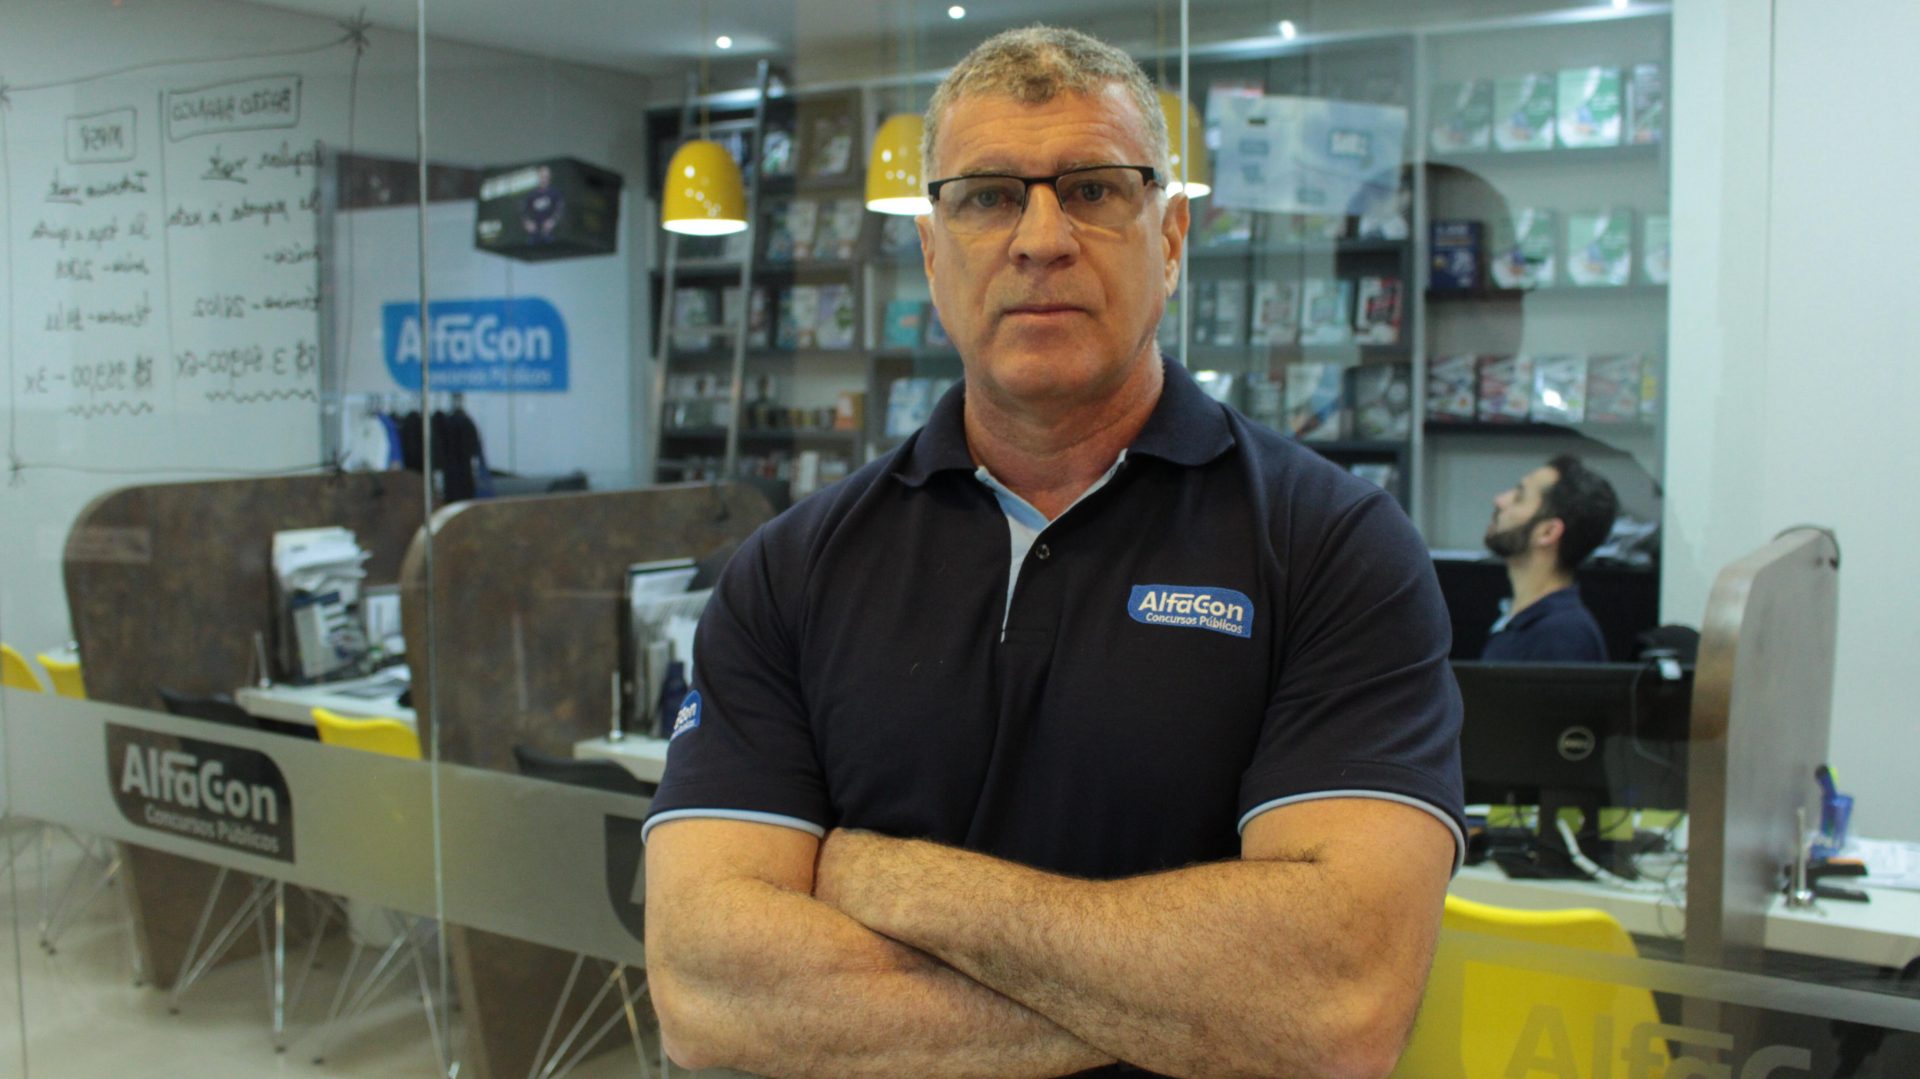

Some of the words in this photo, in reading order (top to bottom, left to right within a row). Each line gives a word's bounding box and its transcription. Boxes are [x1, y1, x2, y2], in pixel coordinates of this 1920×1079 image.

[396, 314, 552, 364] AfaCon
[1138, 591, 1244, 622] AlfaCon
[1145, 612, 1198, 625] Concursos
[1199, 615, 1243, 634] Públicos
[121, 742, 278, 825] AlfaCon
